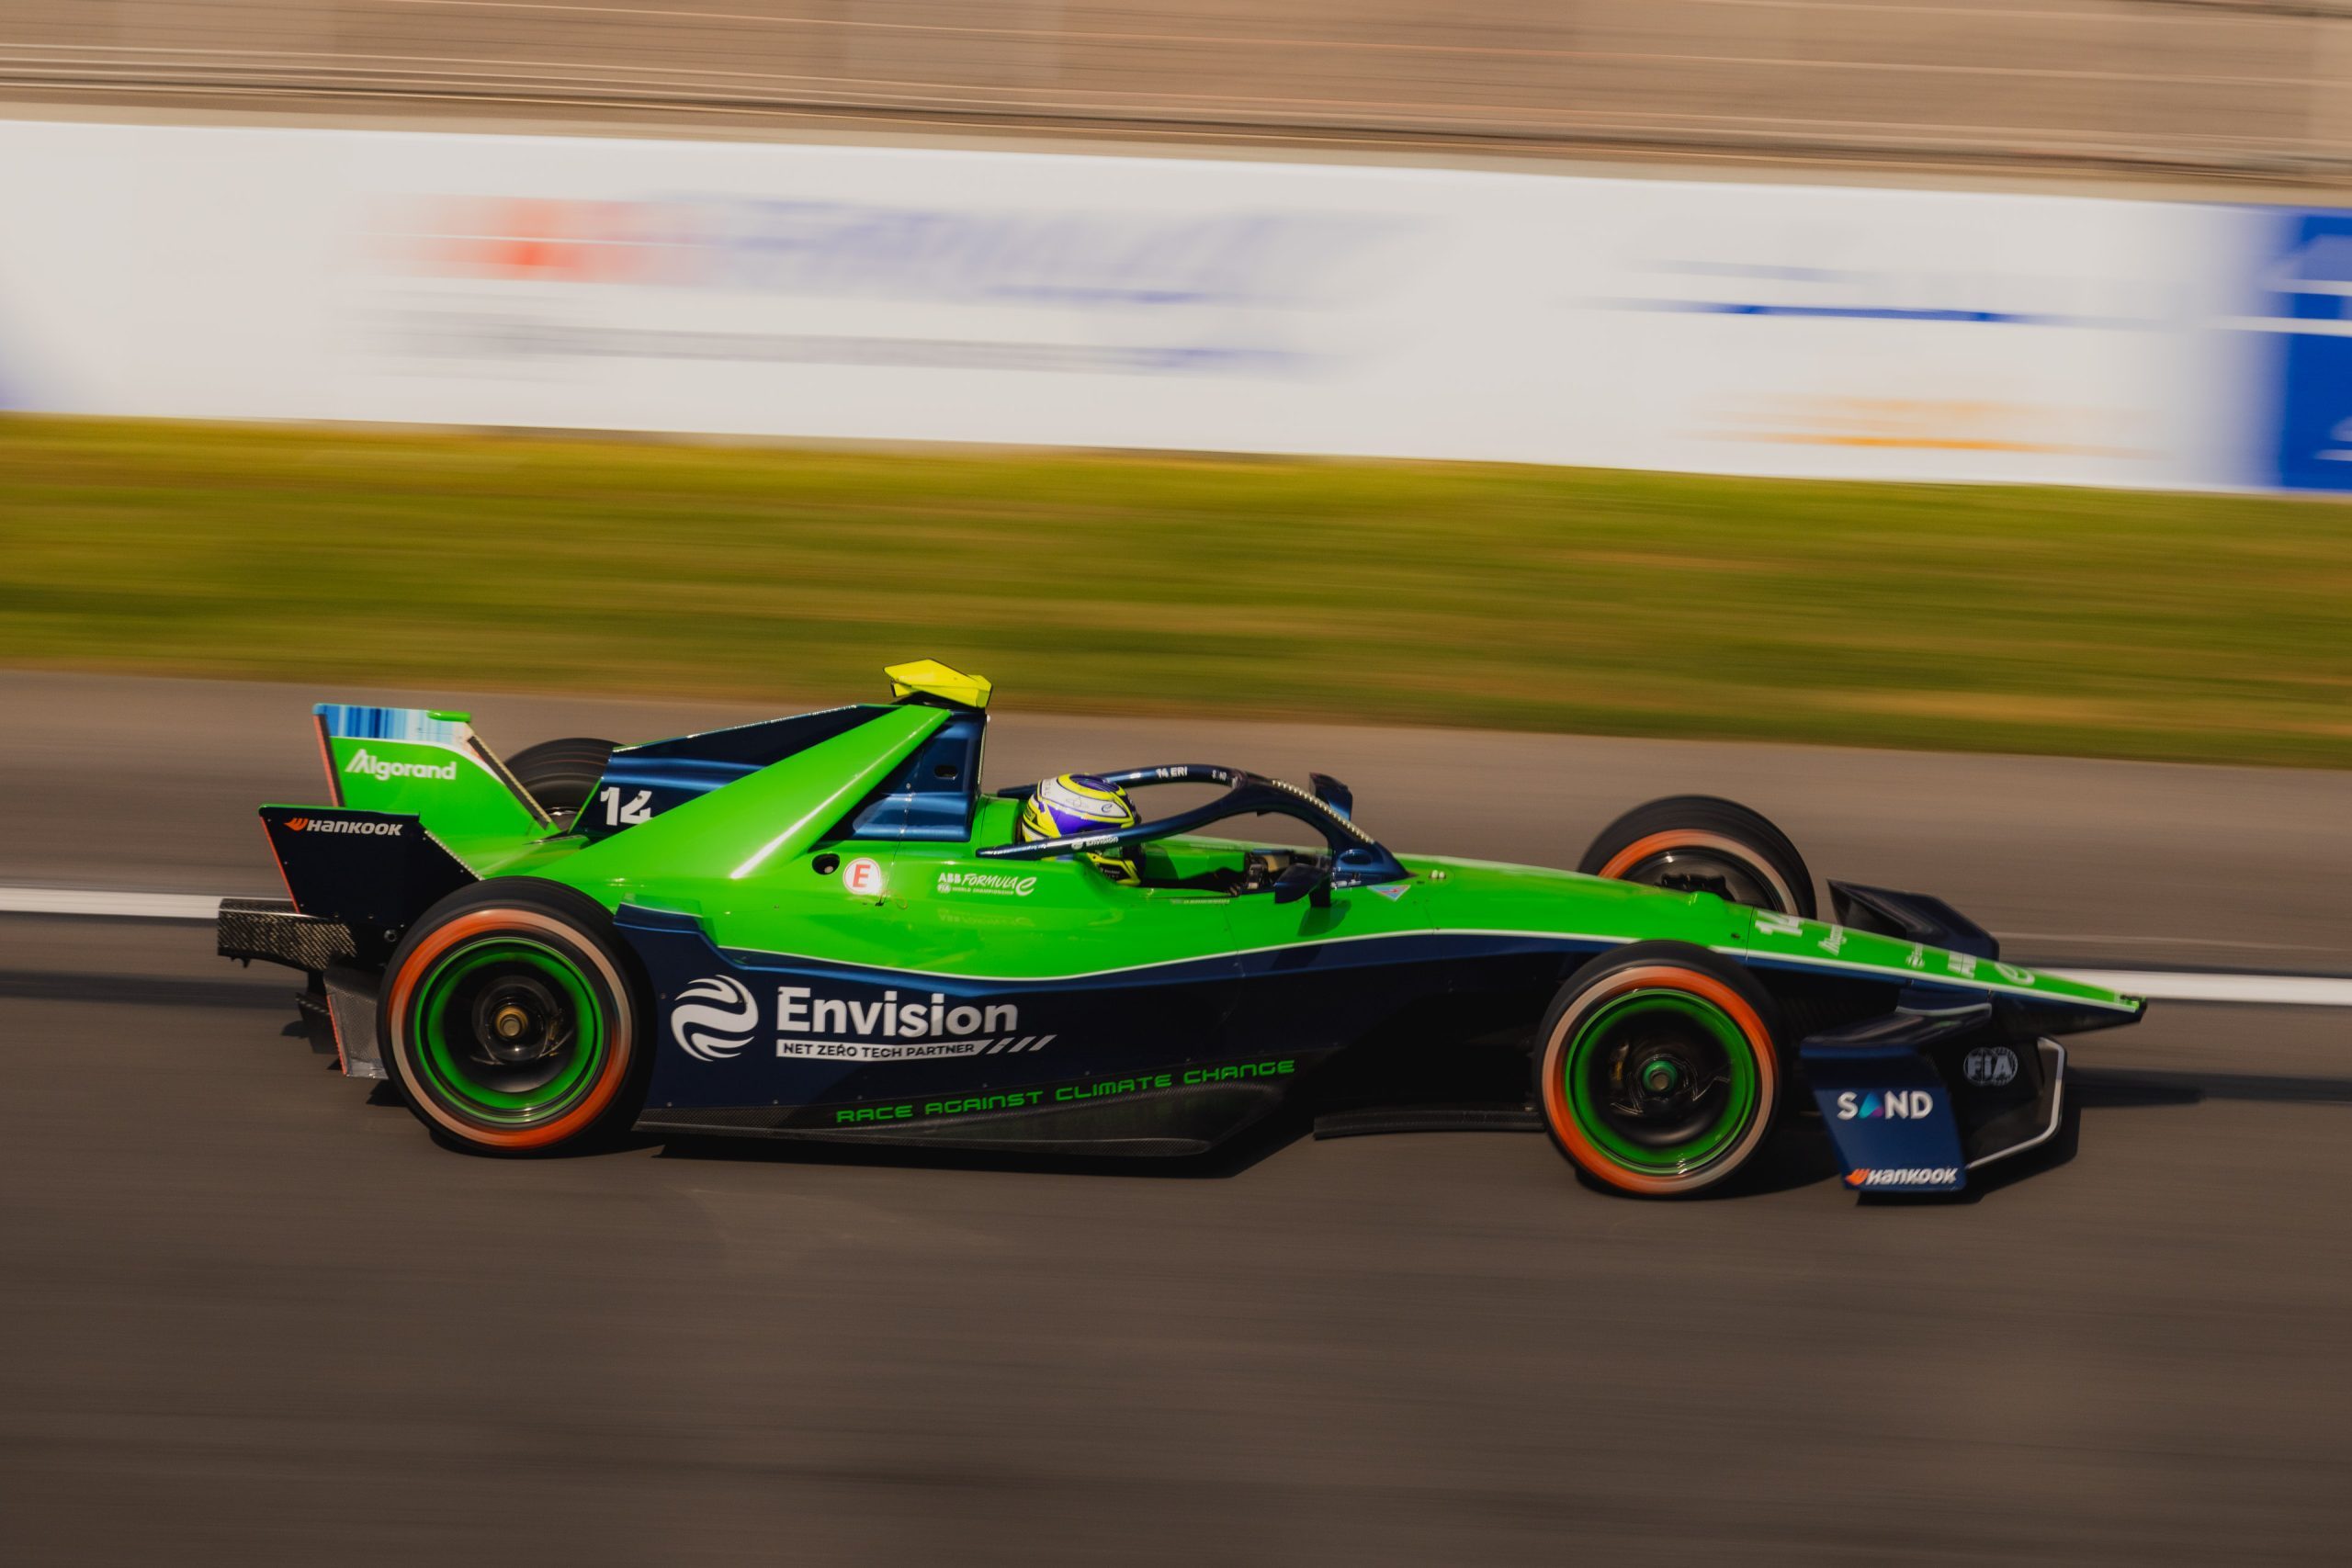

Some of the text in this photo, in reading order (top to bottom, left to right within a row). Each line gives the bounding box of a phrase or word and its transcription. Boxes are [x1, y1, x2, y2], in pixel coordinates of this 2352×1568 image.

[345, 749, 457, 781] Algorand
[600, 786, 653, 826] 14
[853, 863, 871, 888] E
[938, 873, 961, 884] ABB
[961, 873, 1019, 890] FORMULA
[776, 987, 1019, 1038] Envision
[783, 1043, 975, 1058] NET ZERO TECH PARTNER
[1966, 1055, 2013, 1078] FIA
[836, 1060, 1295, 1123] RACE AGAINST CLIMATE CHANGE
